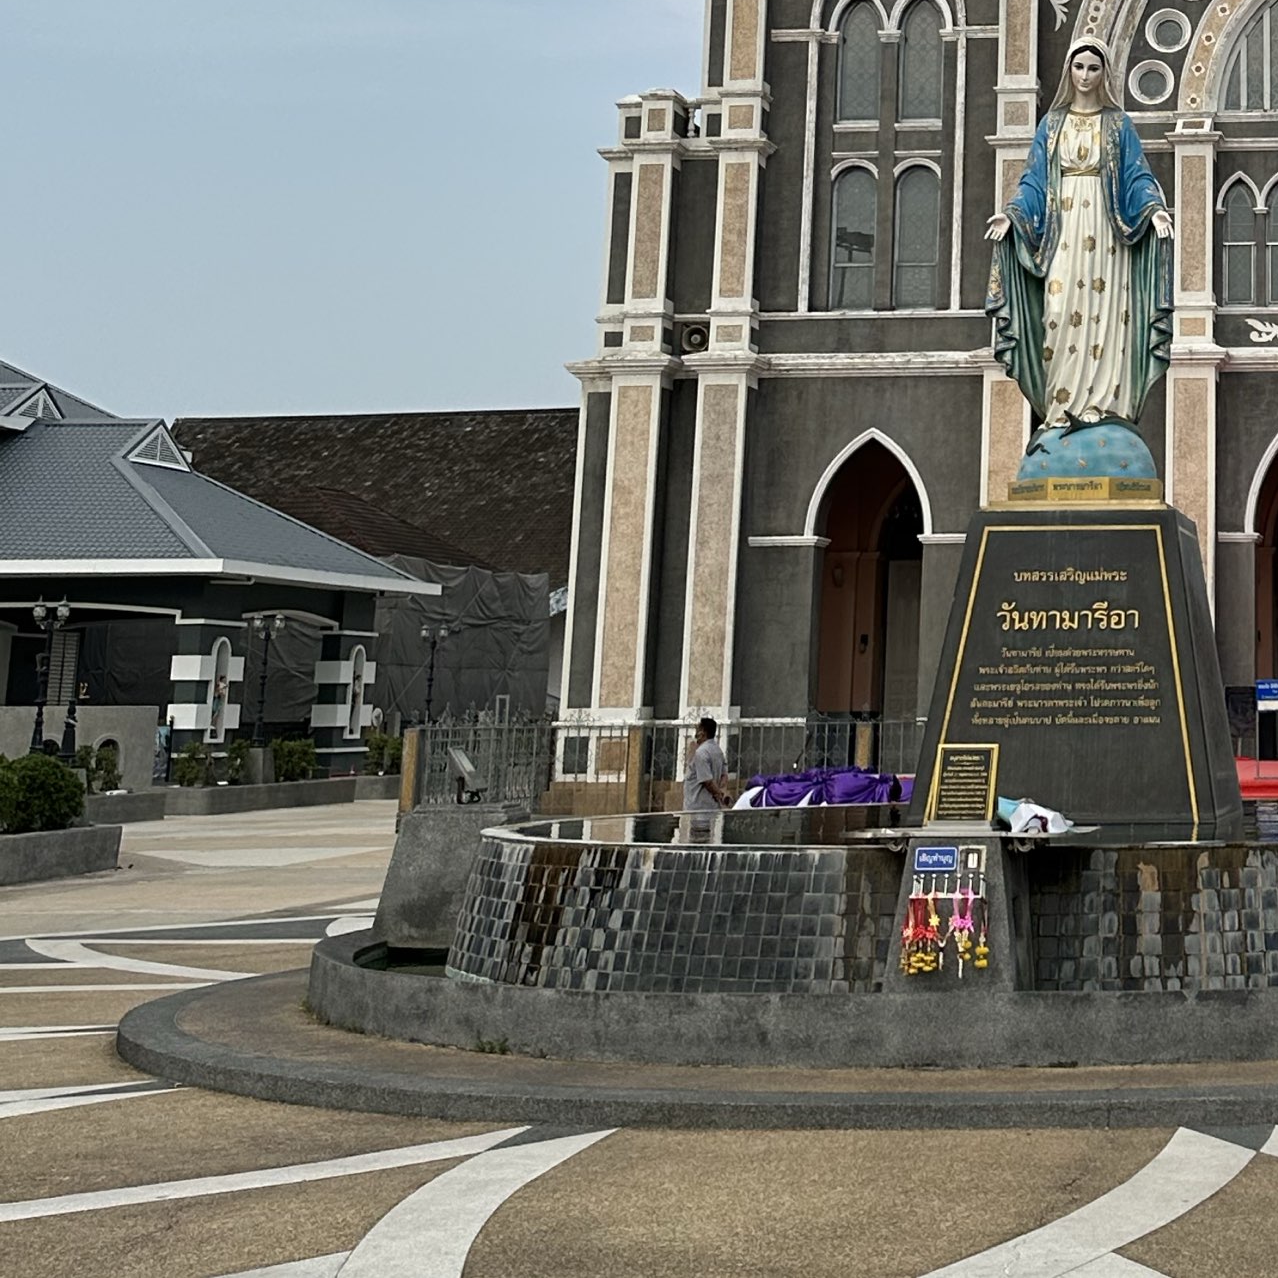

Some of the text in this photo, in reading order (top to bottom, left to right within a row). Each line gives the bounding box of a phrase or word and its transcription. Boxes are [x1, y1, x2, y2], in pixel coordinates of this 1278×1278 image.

[1014, 567, 1128, 585] บทสรรเสริญแม่พระ
[996, 601, 1139, 630] วันทามารีอา
[919, 852, 953, 864] เชิญทำบุญ
